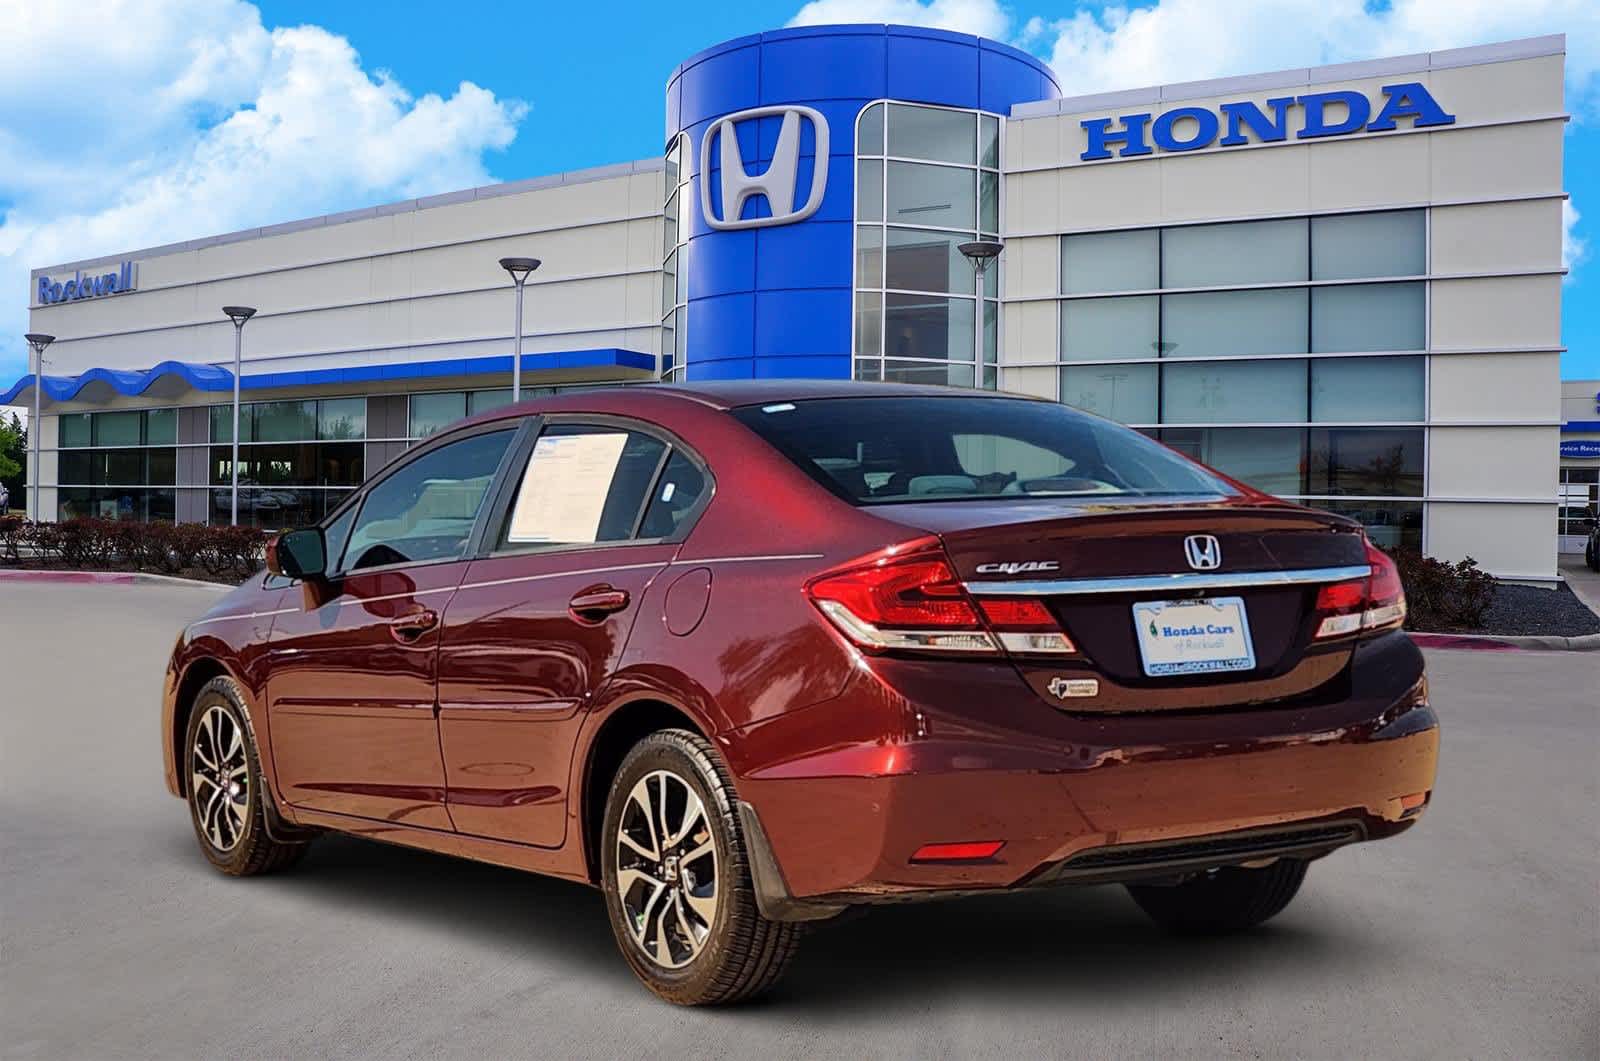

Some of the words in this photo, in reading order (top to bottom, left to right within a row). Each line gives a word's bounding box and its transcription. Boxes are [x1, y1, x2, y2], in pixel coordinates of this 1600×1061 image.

[1080, 82, 1456, 161] HONDA
[38, 260, 132, 304] Rockwall
[1162, 625, 1205, 637] Honda
[1206, 624, 1234, 634] Cars
